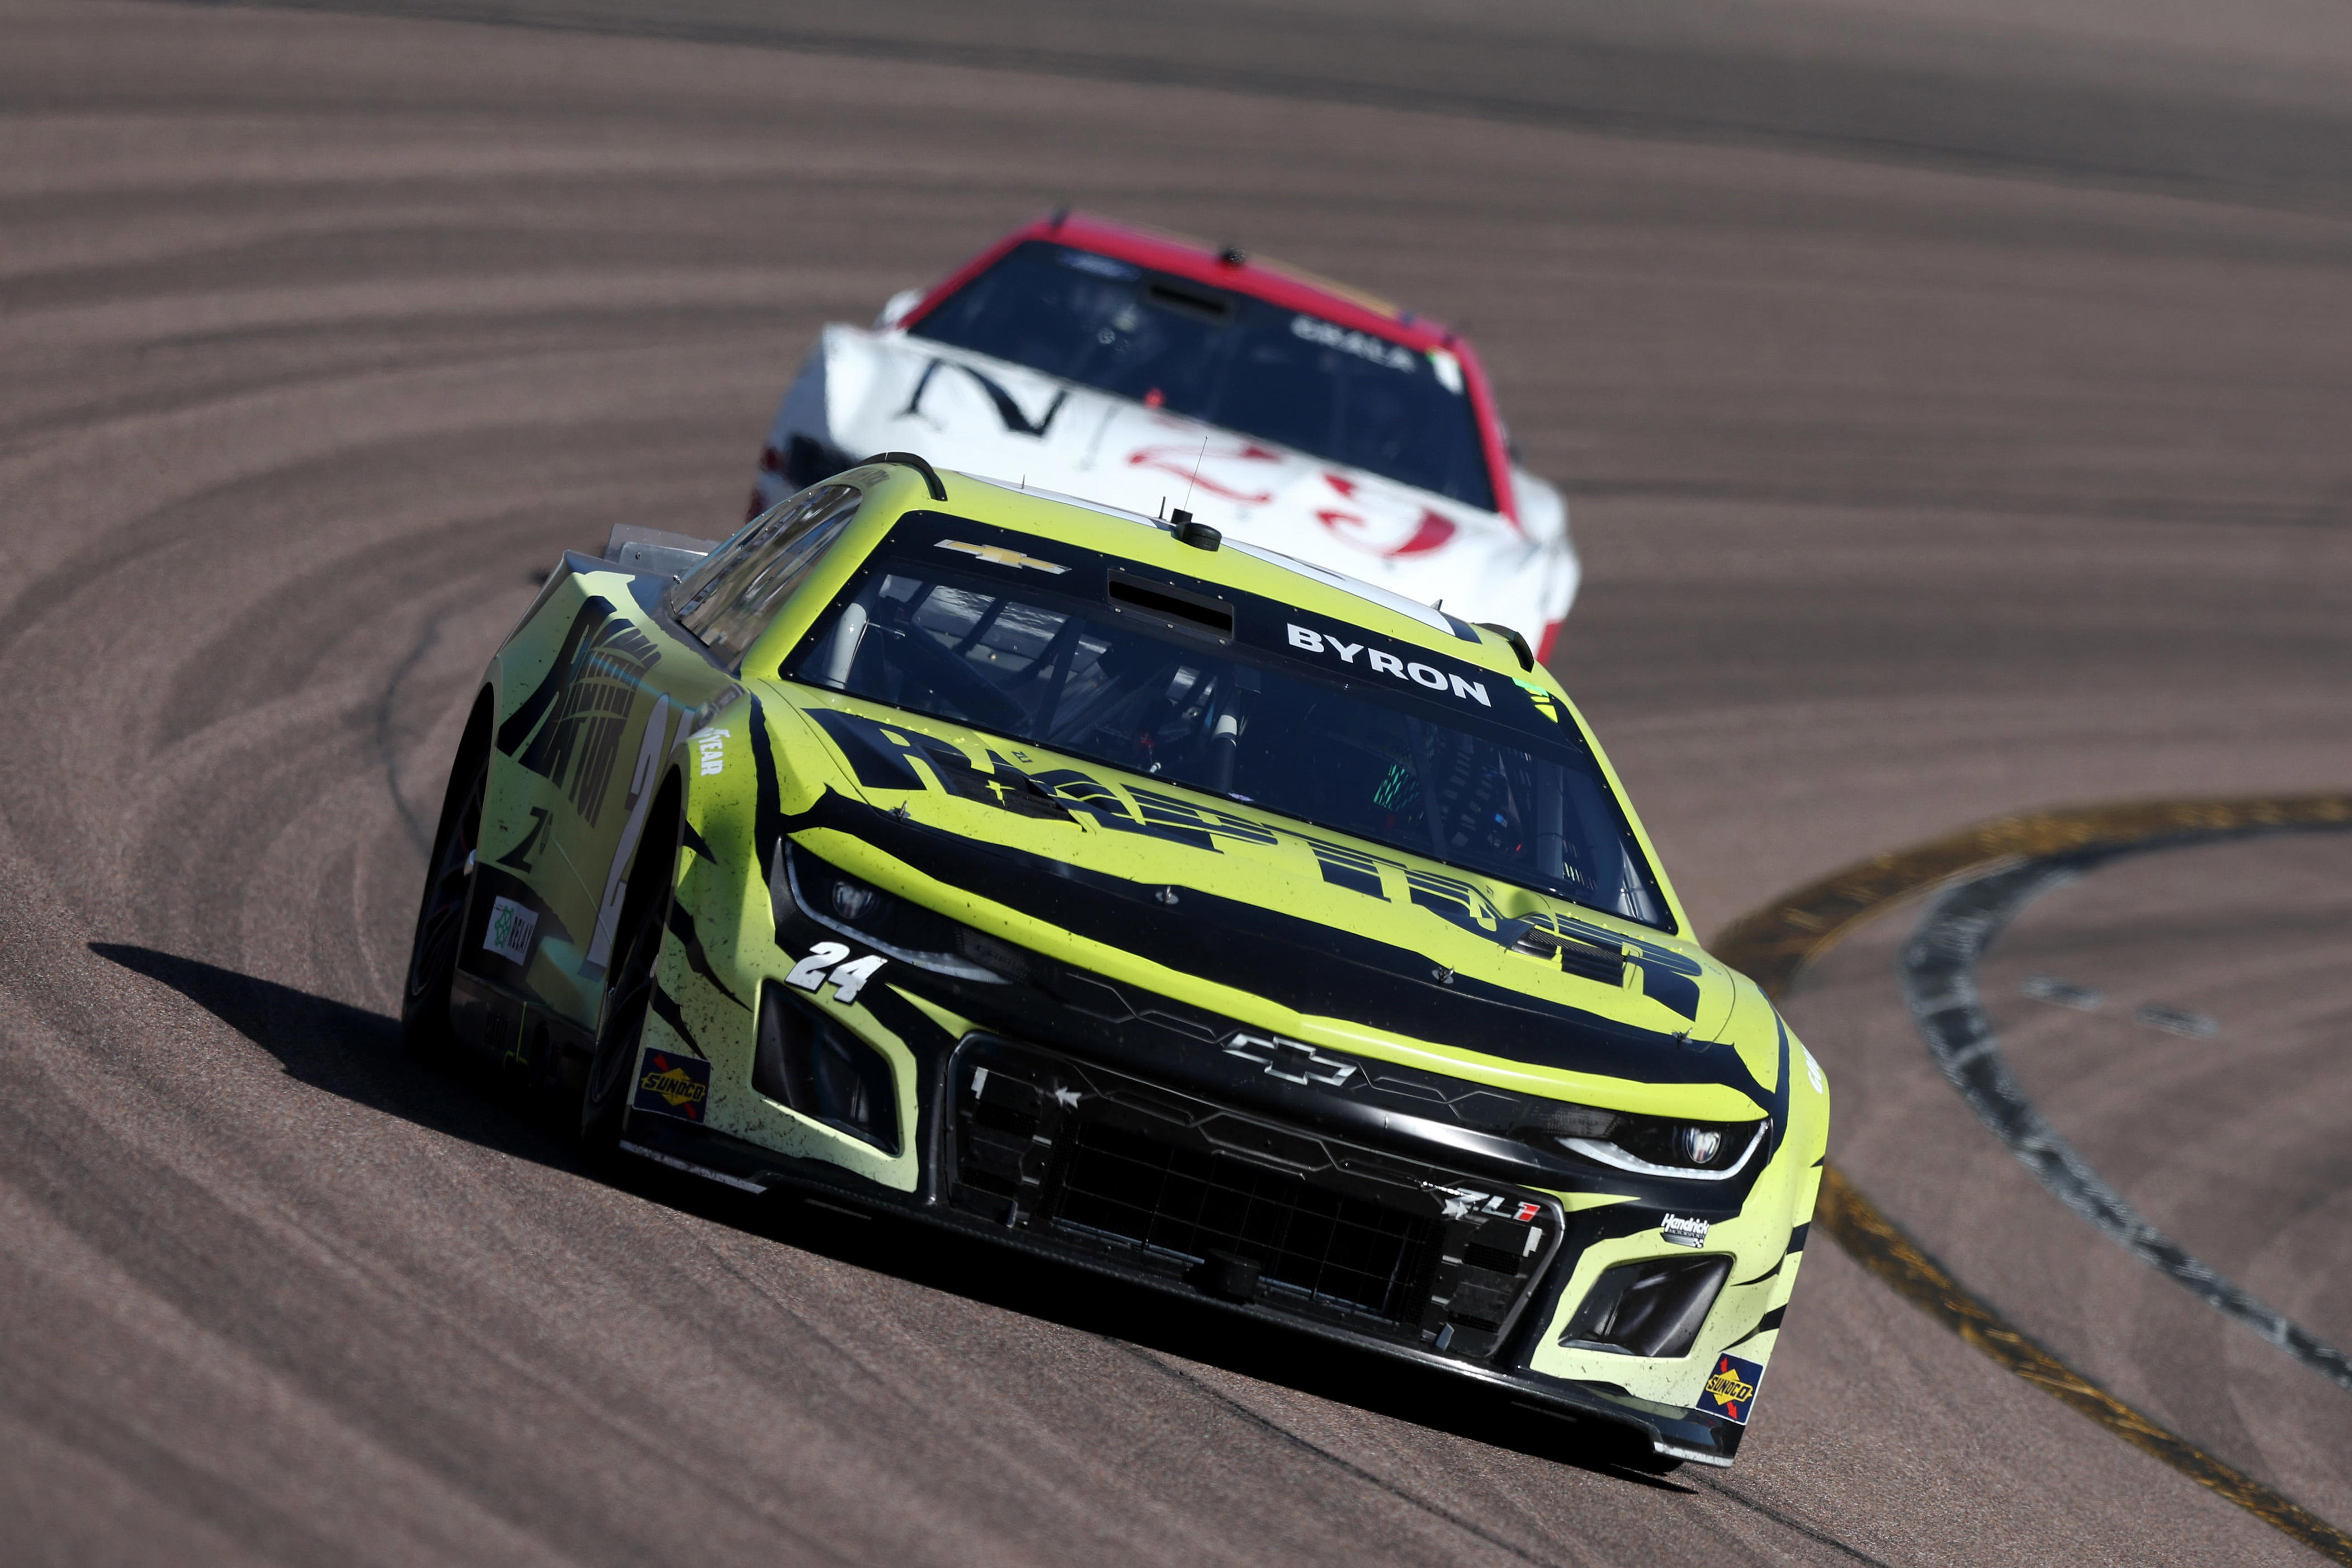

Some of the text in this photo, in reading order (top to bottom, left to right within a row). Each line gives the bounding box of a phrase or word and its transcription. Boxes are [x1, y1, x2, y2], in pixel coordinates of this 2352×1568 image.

[1287, 623, 1492, 707] BYRON
[784, 941, 888, 1005] 24
[644, 1073, 705, 1101] SUNOCO
[1661, 1213, 1709, 1235] Hendrick
[1707, 1376, 1751, 1400] SUNOCO
